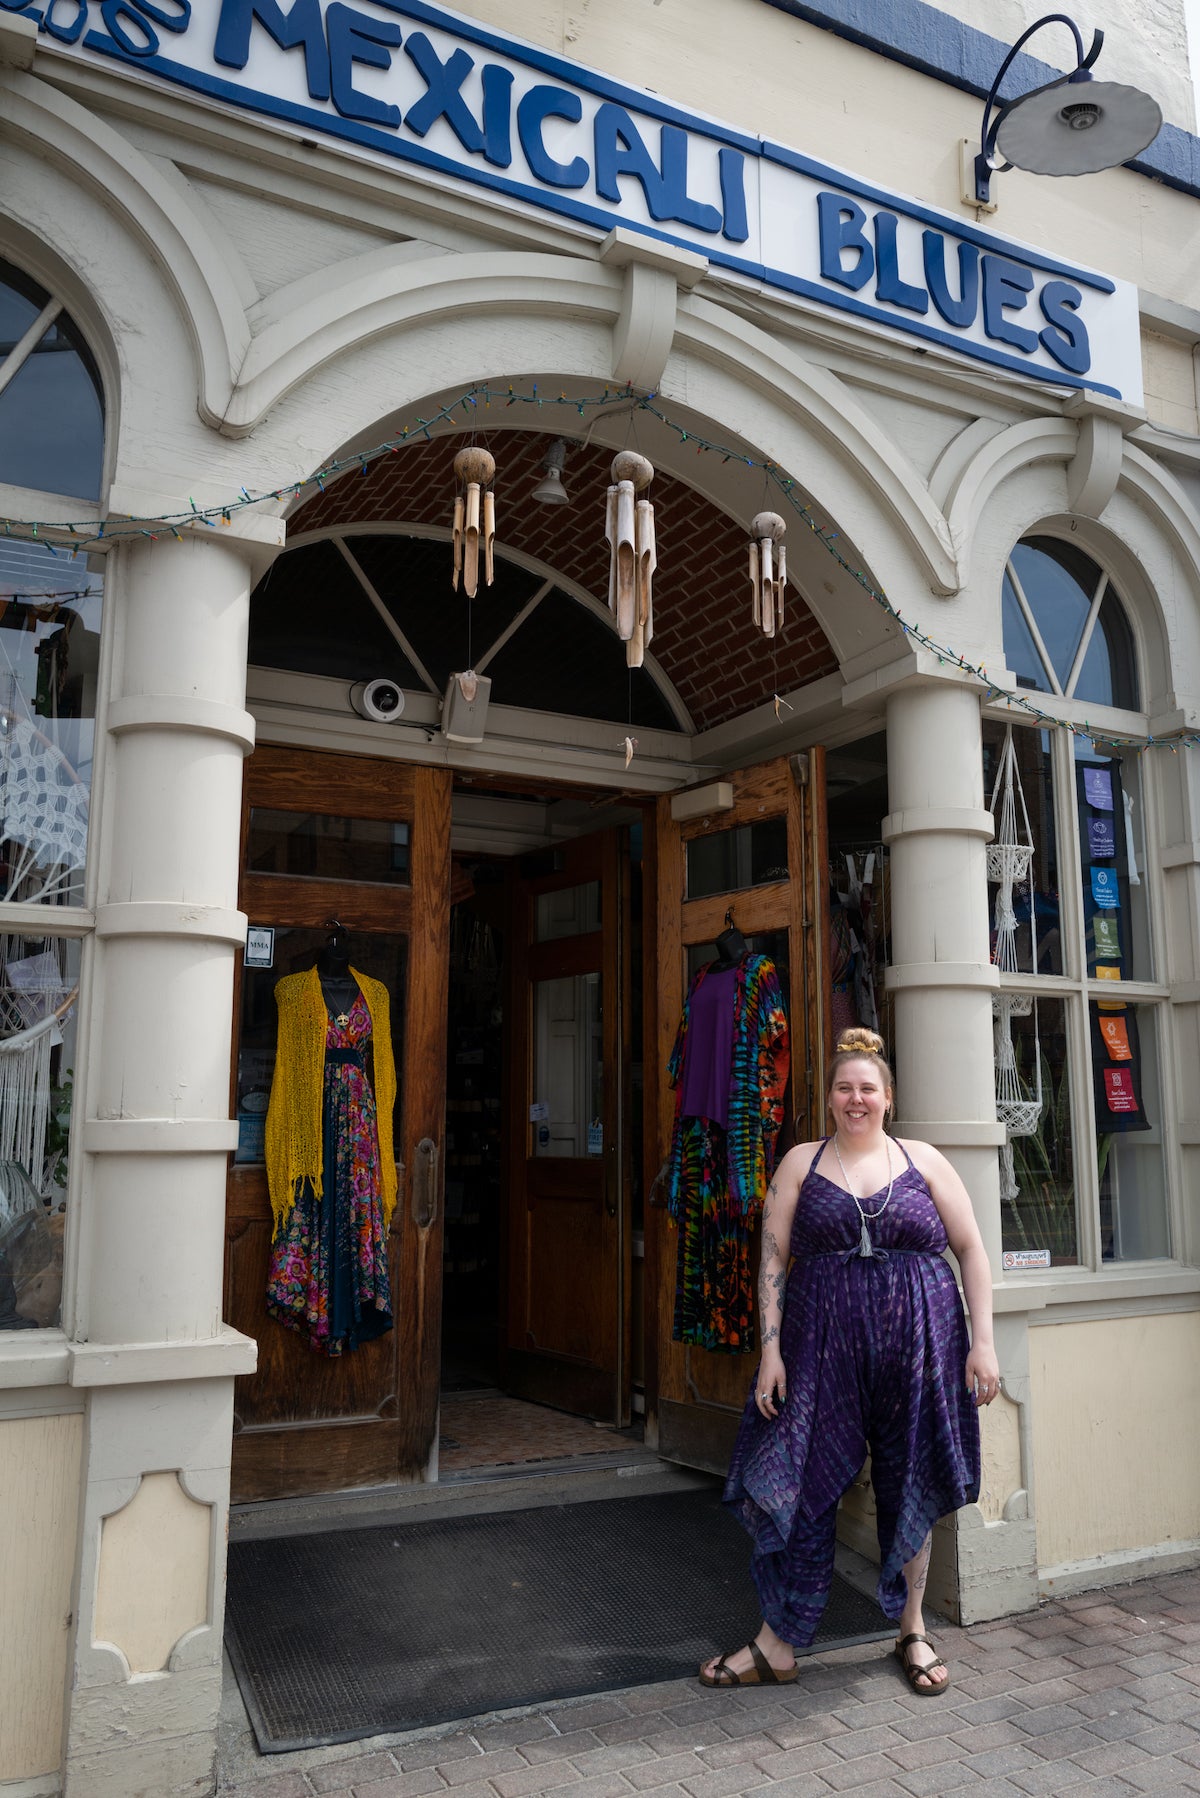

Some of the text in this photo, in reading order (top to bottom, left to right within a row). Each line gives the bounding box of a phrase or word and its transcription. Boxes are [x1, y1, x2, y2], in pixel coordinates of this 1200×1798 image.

[213, 0, 1091, 375] MEXICALI BLUES
[250, 941, 269, 950] MMA
